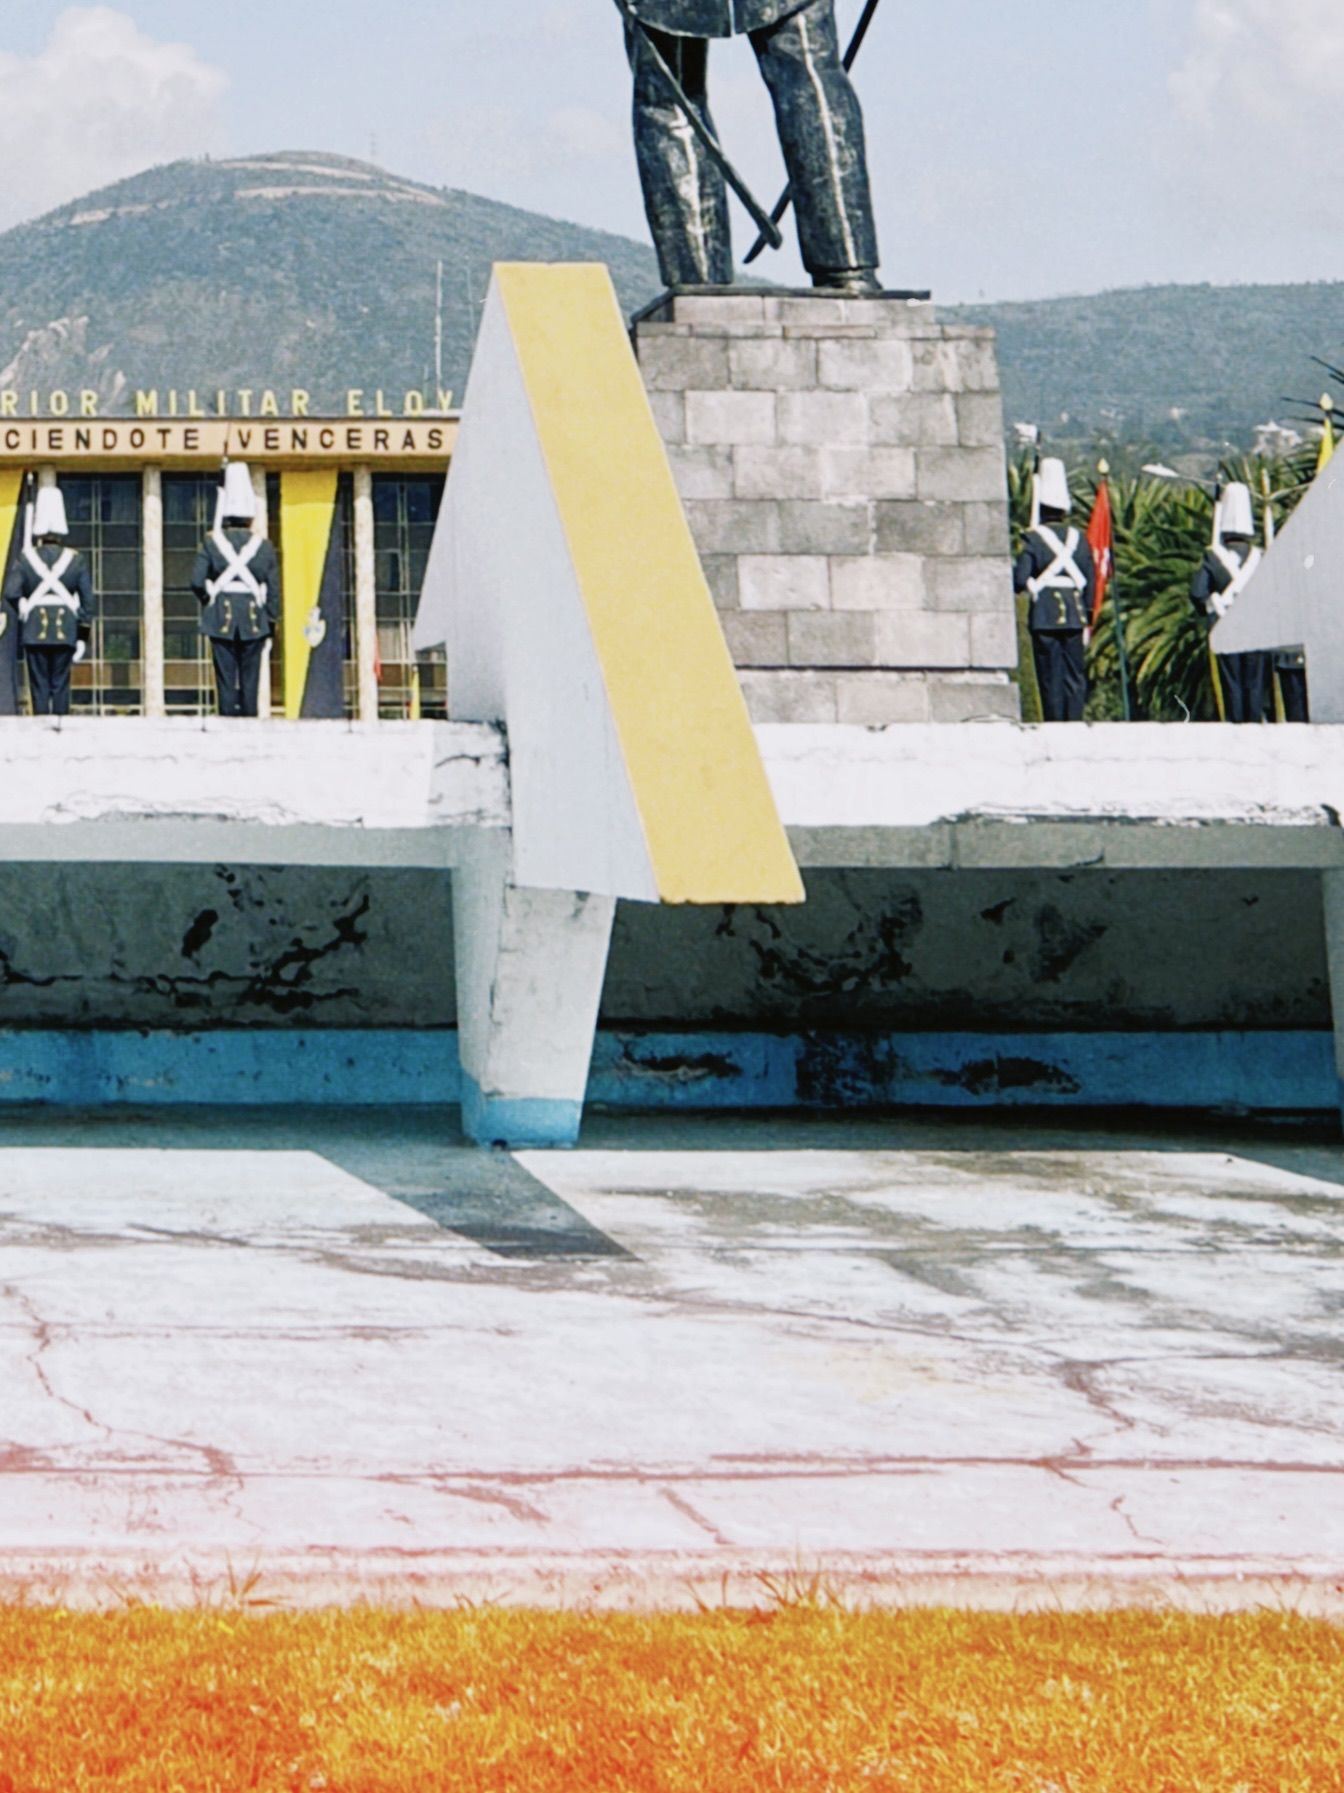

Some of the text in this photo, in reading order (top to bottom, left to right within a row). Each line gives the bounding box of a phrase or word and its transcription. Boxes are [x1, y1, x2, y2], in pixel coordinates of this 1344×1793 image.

[136, 389, 309, 416] MILITAR
[347, 389, 453, 416] ELOY
[237, 428, 443, 450] VENCERAS
